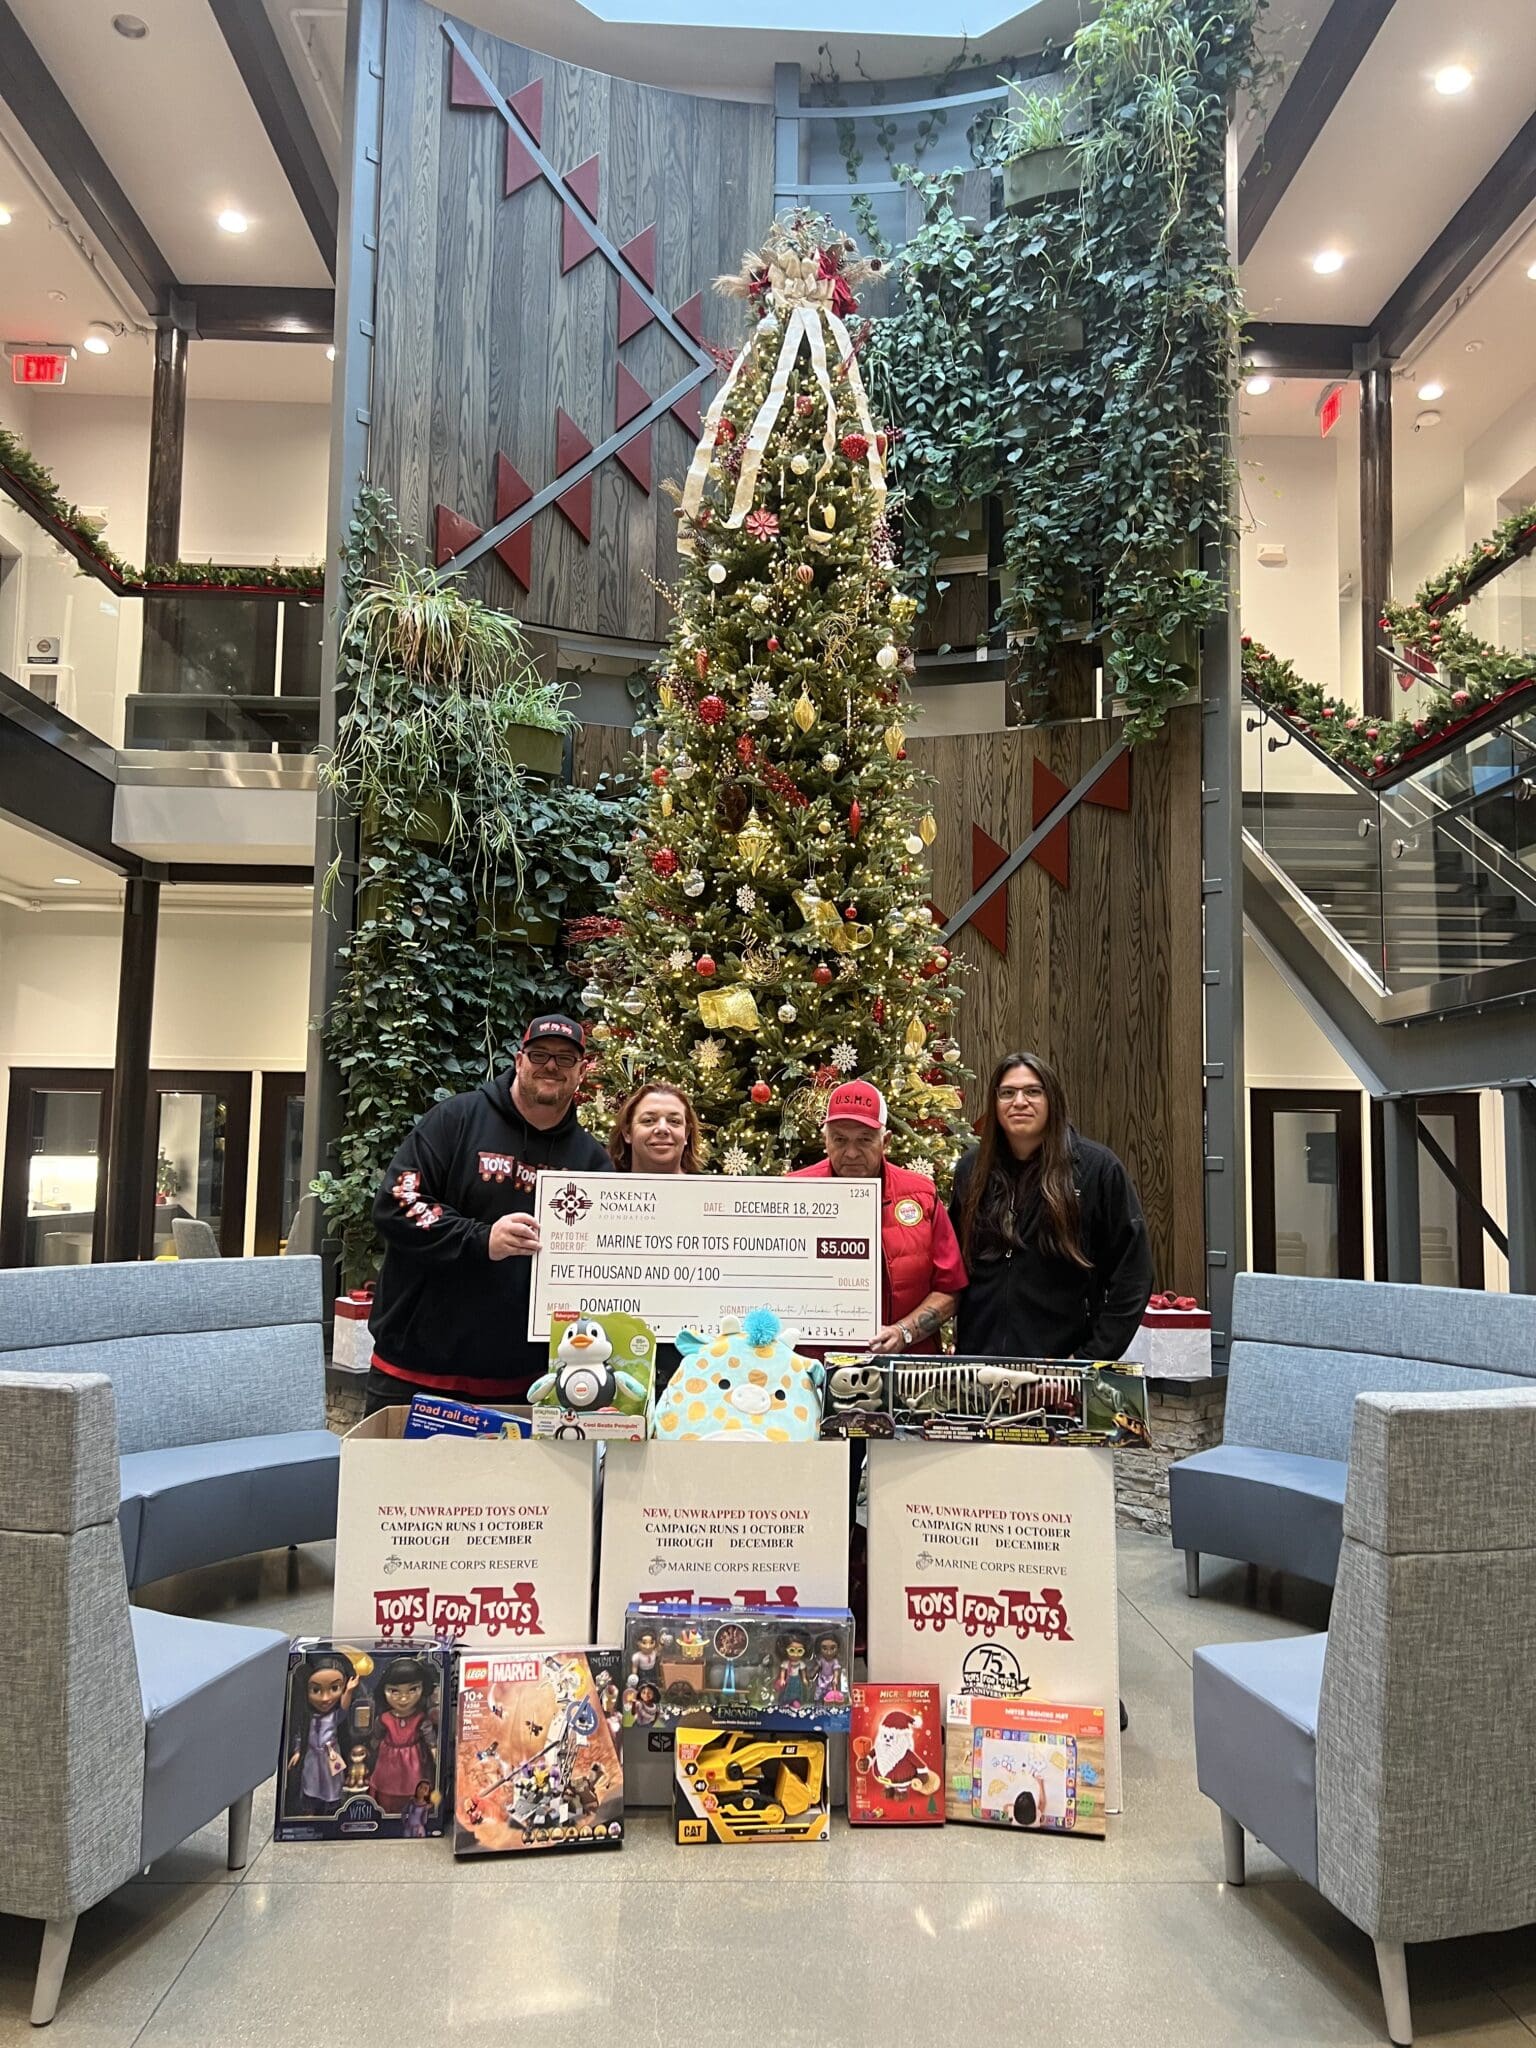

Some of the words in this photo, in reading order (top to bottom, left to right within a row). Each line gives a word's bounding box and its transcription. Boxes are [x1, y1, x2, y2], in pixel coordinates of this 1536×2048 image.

[24, 356, 56, 381] EXIT
[481, 1157, 511, 1173] TOYS
[516, 1165, 536, 1184] FOR
[600, 1191, 657, 1201] PASKENTA
[850, 1189, 869, 1198] 1234
[600, 1202, 656, 1212] NOMLAKI
[703, 1202, 724, 1212] DATE:
[734, 1202, 789, 1214] DECEMBER
[793, 1202, 809, 1215] 18,
[812, 1203, 839, 1215] 2023
[551, 1232, 564, 1240] PAY
[565, 1232, 573, 1240] TO
[575, 1232, 589, 1240] THE
[550, 1242, 574, 1250] ORDER
[596, 1234, 642, 1250] MARINE
[644, 1235, 673, 1250] TOYS
[676, 1236, 699, 1250] FOR
[702, 1236, 730, 1251] TOTS
[733, 1237, 806, 1253] FOUNDATION
[820, 1242, 865, 1255] $5,000
[551, 1265, 576, 1278] FIVE
[578, 1265, 642, 1280] THOUSAND
[644, 1266, 670, 1281] AND
[673, 1267, 720, 1282] 00/100
[838, 1278, 869, 1287] DOLLARS
[580, 1298, 640, 1312] DONATION
[414, 1403, 440, 1415] road
[442, 1409, 461, 1420] rail
[462, 1415, 480, 1425] set
[378, 1506, 408, 1516] NEW,
[410, 1506, 483, 1516] UNWRAPPED
[485, 1507, 516, 1516] TOYS
[518, 1506, 549, 1516] ONLY
[642, 1508, 671, 1519] NEW,
[674, 1509, 746, 1519] UNWRAPPED
[748, 1510, 777, 1519] TOYS
[780, 1510, 810, 1520] ONLY
[906, 1504, 934, 1516] NEW,
[936, 1506, 1007, 1520] UNWRAPPED
[1009, 1511, 1040, 1522] TOYS
[1042, 1513, 1072, 1524] ONLY
[381, 1522, 442, 1531] CAMPAIGN
[446, 1522, 476, 1531] RUNS
[487, 1521, 543, 1530] OCTOBER
[645, 1524, 706, 1533] CAMPAIGN
[710, 1524, 739, 1534] RUNS
[750, 1525, 804, 1534] OCTOBER
[912, 1519, 972, 1532] CAMPAIGN
[975, 1524, 1004, 1534] RUNS
[1015, 1527, 1071, 1538] OCTOBER
[391, 1536, 449, 1545] THROUGH
[467, 1535, 532, 1545] DECEMBER
[656, 1538, 713, 1547] THROUGH
[730, 1538, 793, 1548] DECEMBER
[923, 1533, 979, 1546] THROUGH
[996, 1539, 1060, 1551] DECEMBER
[403, 1561, 447, 1570] MARINE
[450, 1560, 486, 1569] CORPS
[489, 1560, 538, 1569] RESERVE
[668, 1562, 711, 1572] MARINE
[714, 1563, 749, 1572] CORPS
[752, 1563, 800, 1572] RESERVE
[935, 1558, 978, 1570] MARINE
[980, 1562, 1015, 1572] CORPS
[1018, 1563, 1067, 1576] RESERVE
[379, 1595, 424, 1620] TOYS
[435, 1600, 471, 1622] FOR
[483, 1602, 532, 1623] TOTS
[910, 1593, 953, 1616] TOYS
[964, 1599, 1000, 1623] FOR
[1011, 1605, 1060, 1629] TOTS
[466, 1670, 486, 1680] LEGO
[494, 1663, 537, 1682] MARVEL
[464, 1692, 483, 1701] 10+
[350, 1805, 372, 1820] WISH
[684, 1825, 702, 1836] CAT
